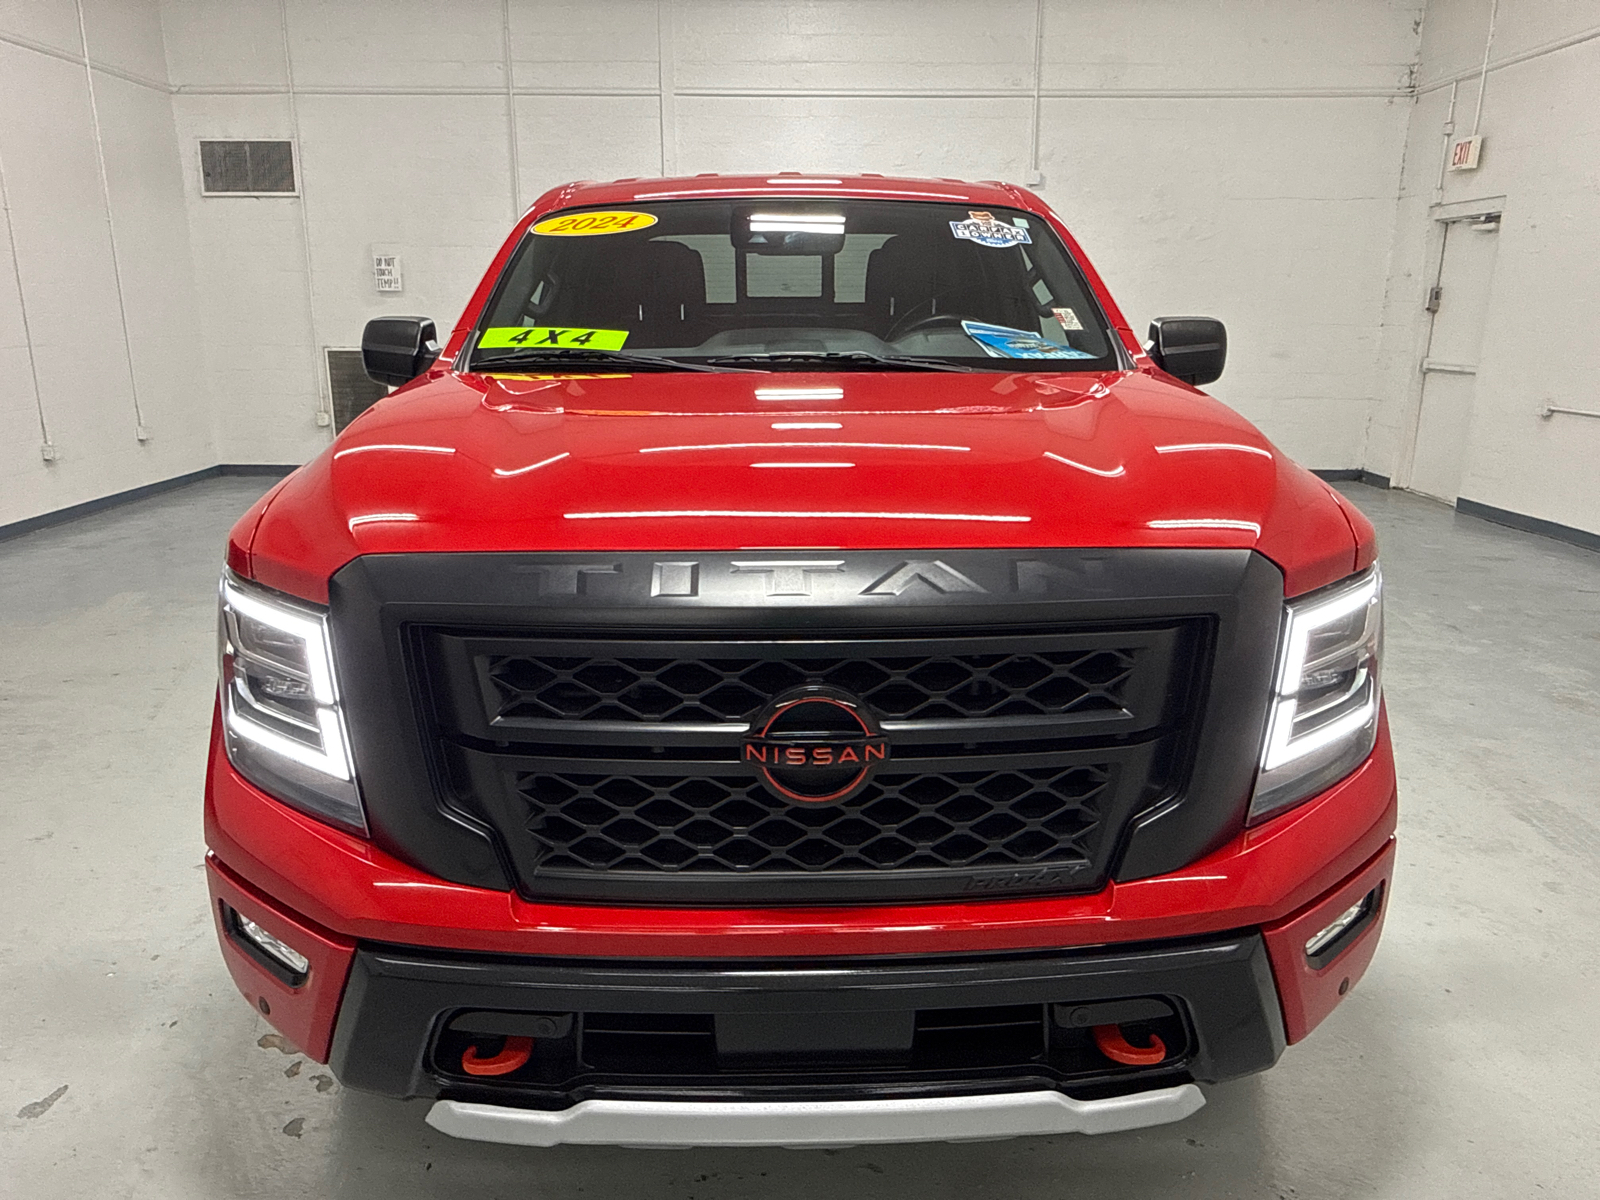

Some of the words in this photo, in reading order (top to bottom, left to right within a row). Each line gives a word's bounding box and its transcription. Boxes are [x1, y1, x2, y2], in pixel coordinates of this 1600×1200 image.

[1452, 140, 1472, 166] EXIT
[549, 215, 639, 232] 2024
[376, 257, 382, 267] DO
[384, 257, 396, 267] NOT
[516, 558, 1112, 597] TITAN
[745, 743, 885, 765] NISSAN
